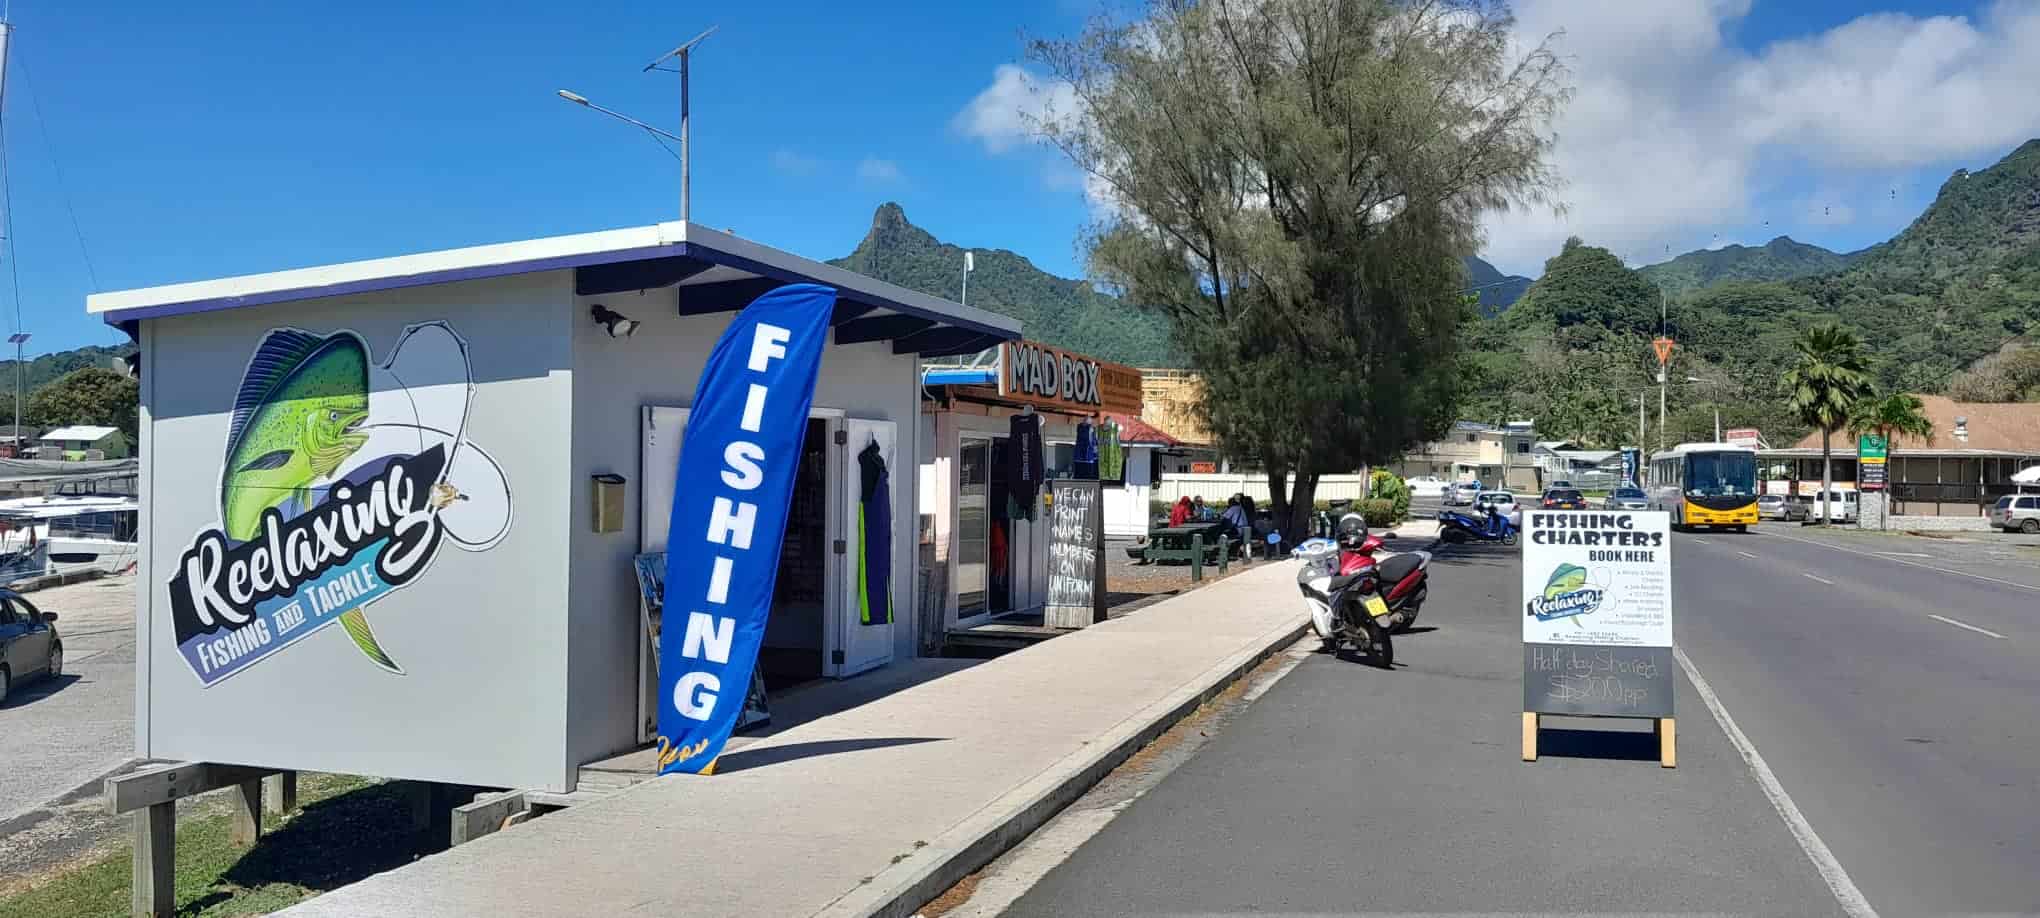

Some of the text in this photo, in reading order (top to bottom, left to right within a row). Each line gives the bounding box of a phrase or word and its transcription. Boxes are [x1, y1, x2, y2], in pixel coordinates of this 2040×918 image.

[1008, 341, 1059, 398] MAD
[1060, 353, 1101, 406] BOX
[1054, 487, 1095, 504] WE CAN
[673, 322, 791, 721] FISHING
[1054, 503, 1088, 525] PRINT
[1532, 514, 1633, 530] FISHING
[187, 464, 435, 626] Reelaxing
[1532, 530, 1663, 547] CHARTERS
[1589, 550, 1655, 562] BOOK HERE
[1060, 561, 1075, 576] ON
[1048, 576, 1093, 595] UNIFORM
[1532, 589, 1599, 616] Reelaxing
[197, 563, 378, 674] FISHING AND TACKLE
[1533, 647, 1561, 673] Half
[1567, 648, 1594, 678] day
